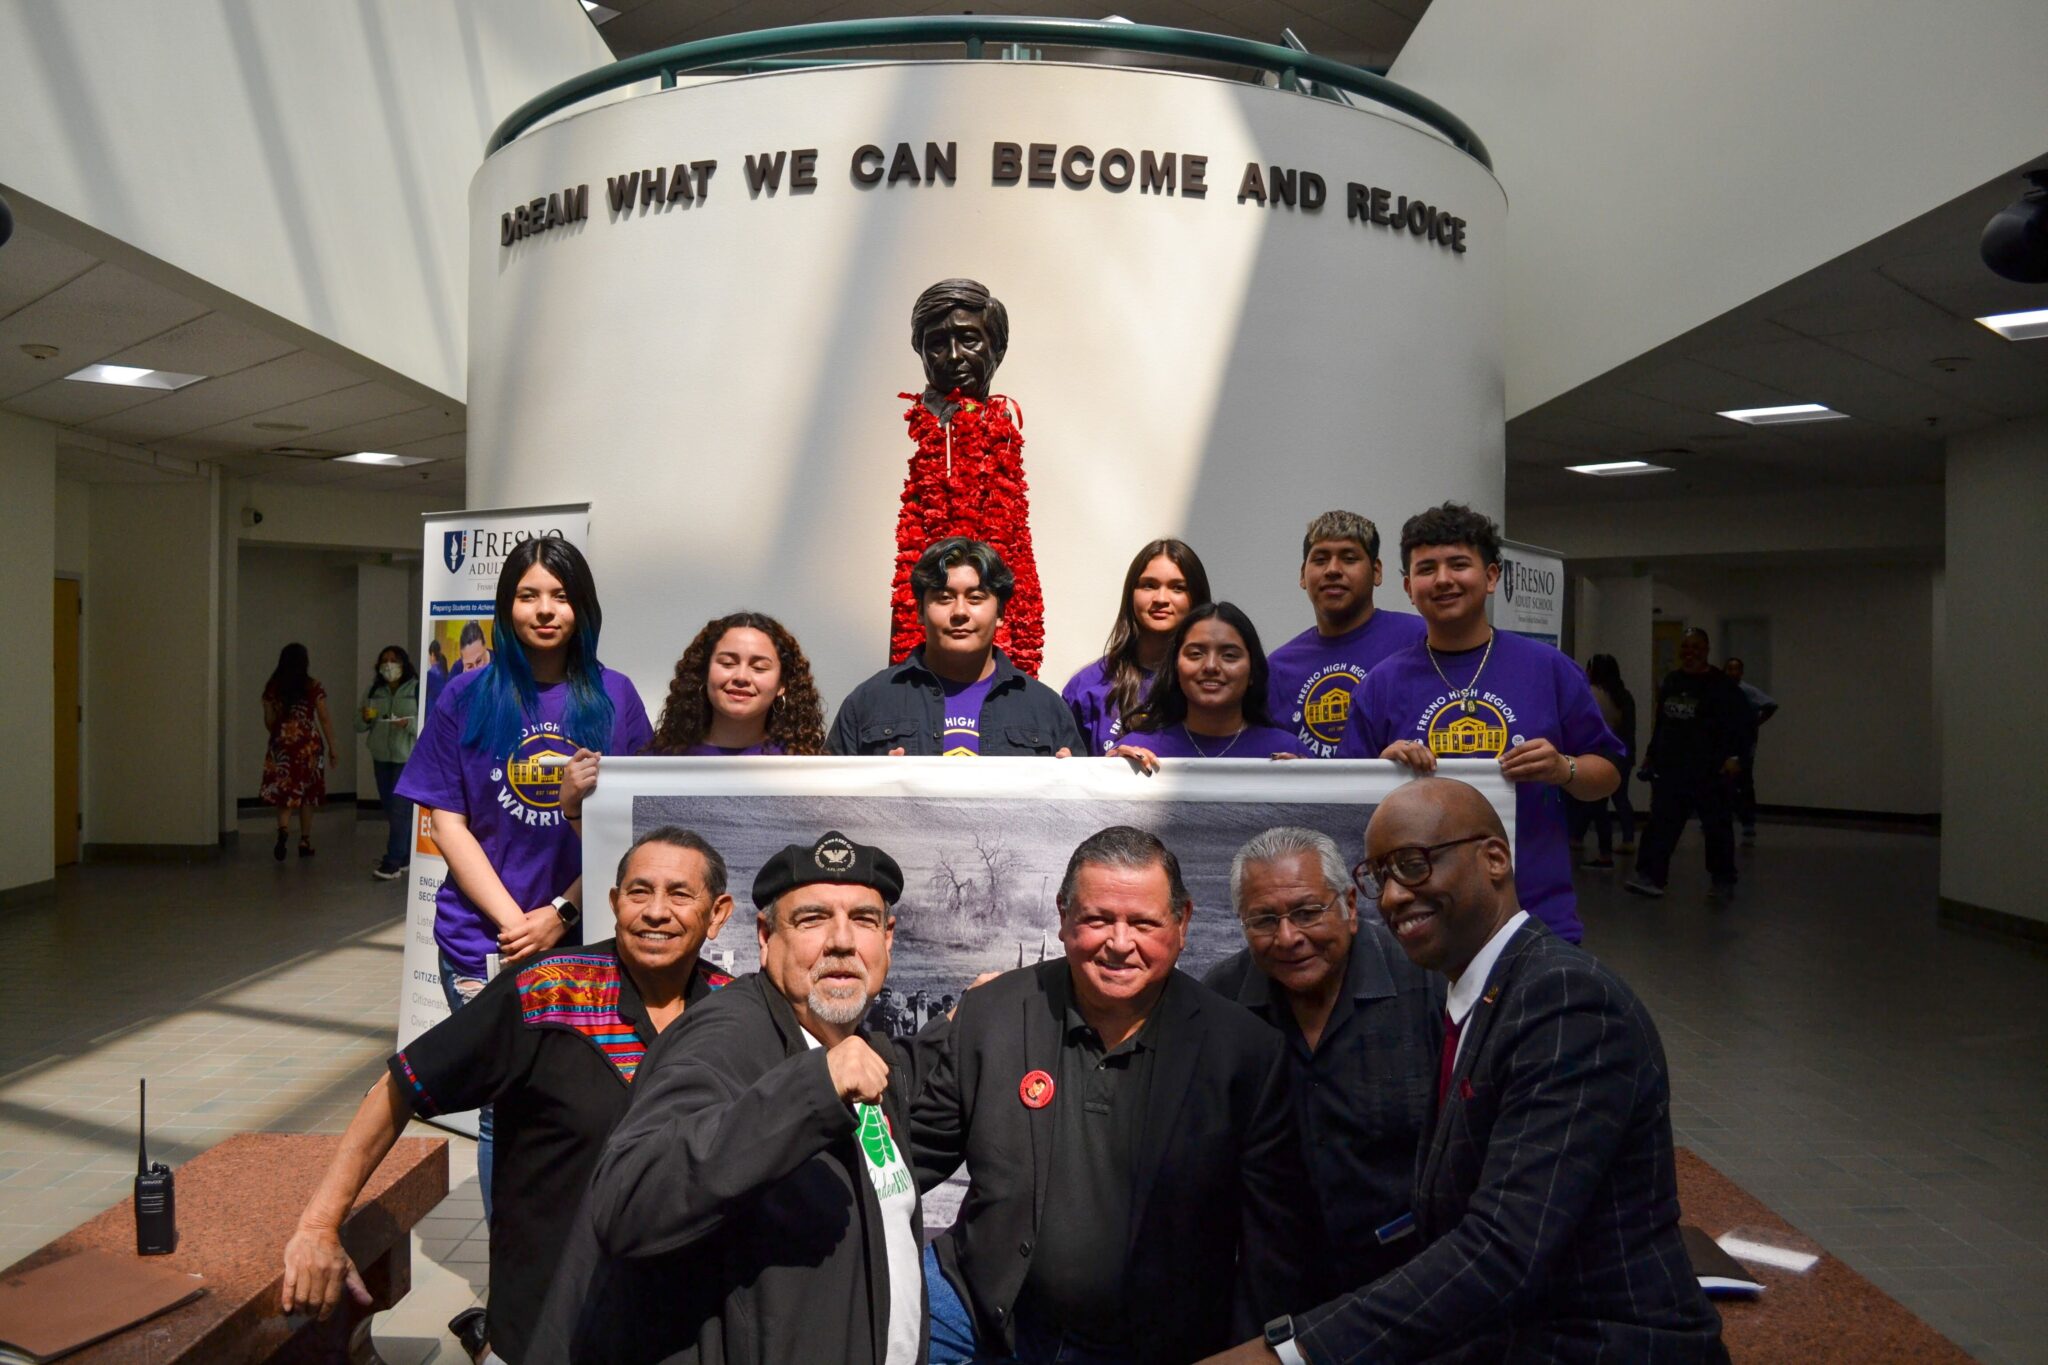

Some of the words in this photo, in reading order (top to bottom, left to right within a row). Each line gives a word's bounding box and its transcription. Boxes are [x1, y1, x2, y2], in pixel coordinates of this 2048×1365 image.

[501, 184, 589, 247] DREAM
[607, 159, 717, 212] WHAT
[745, 148, 818, 192] WE
[851, 141, 957, 185] CAN
[993, 141, 1208, 194] BECOME
[1238, 162, 1327, 209] AND
[1347, 182, 1467, 254] REJOICE
[1515, 562, 1555, 596] FRESNO
[432, 604, 451, 613] Preparing
[1297, 671, 1321, 704] FRESNO
[1323, 662, 1347, 675] HIGH
[945, 716, 975, 728] HIGH
[1417, 696, 1446, 731] FRESNO
[1448, 688, 1478, 700] HIGH
[1482, 691, 1517, 723] REGION
